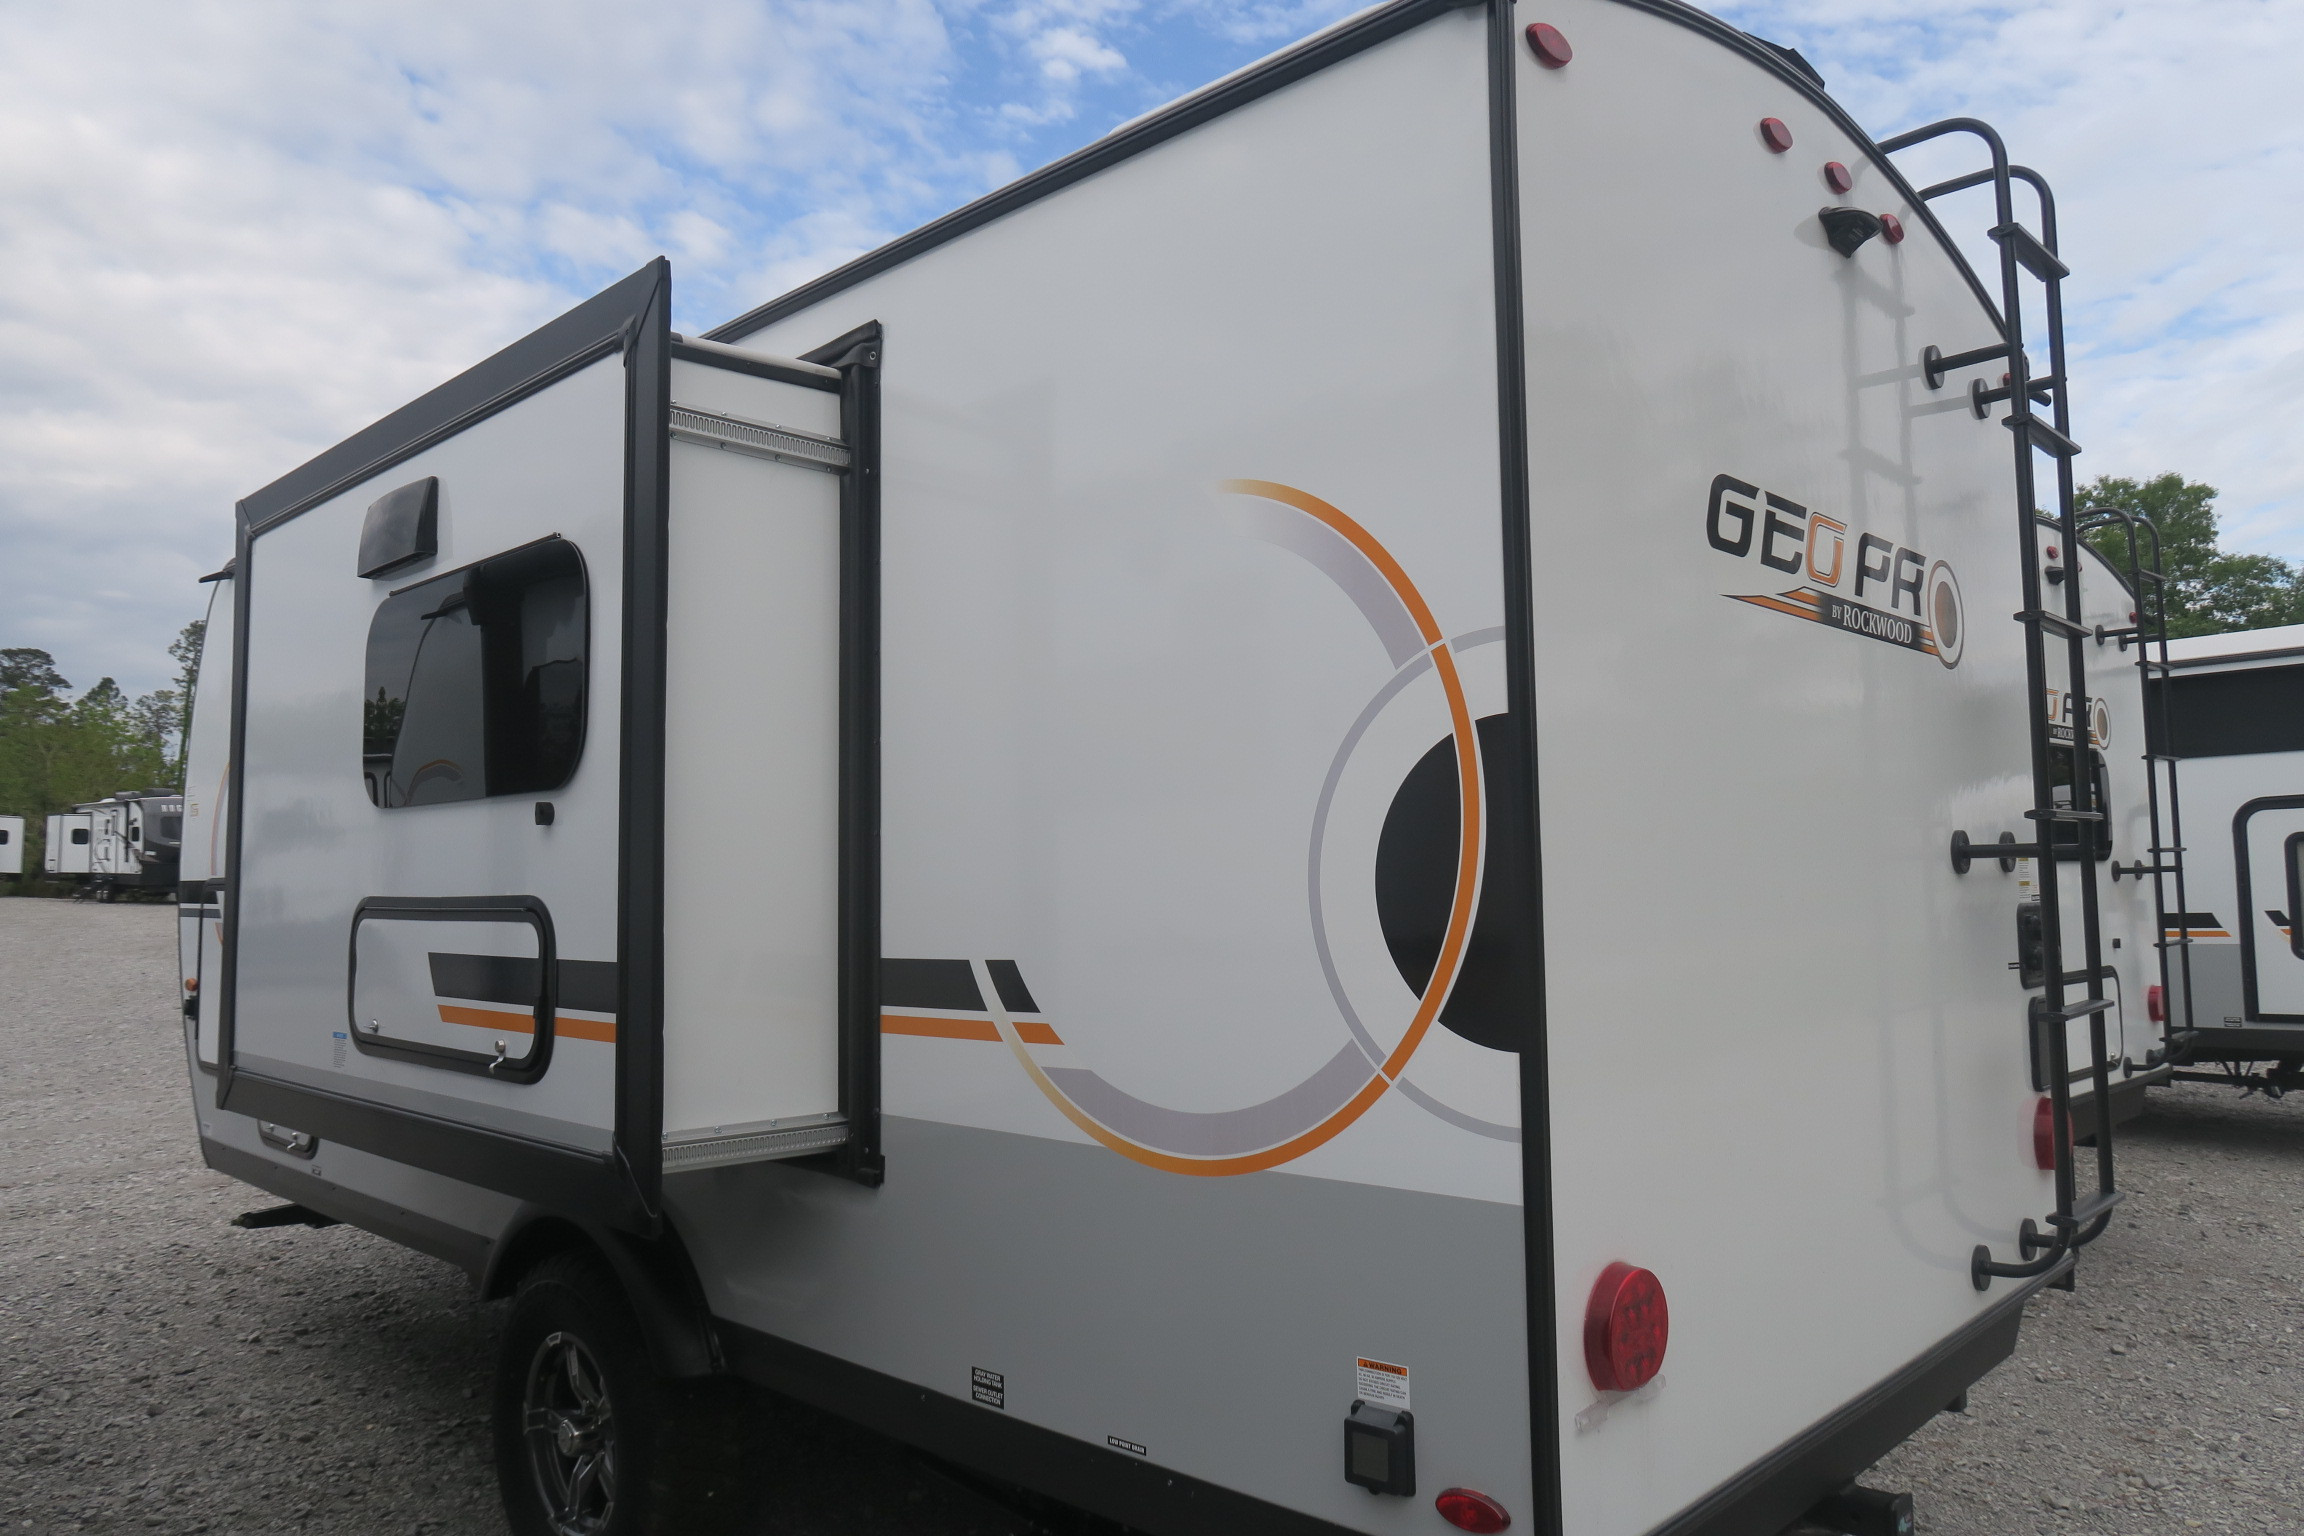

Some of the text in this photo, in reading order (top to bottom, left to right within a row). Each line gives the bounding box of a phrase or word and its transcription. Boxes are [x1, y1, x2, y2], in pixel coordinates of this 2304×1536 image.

[1706, 473, 1964, 670] GEO PRO
[1832, 604, 1912, 644] BY ROCKWOOD
[1368, 1362, 1402, 1374] WARNING
